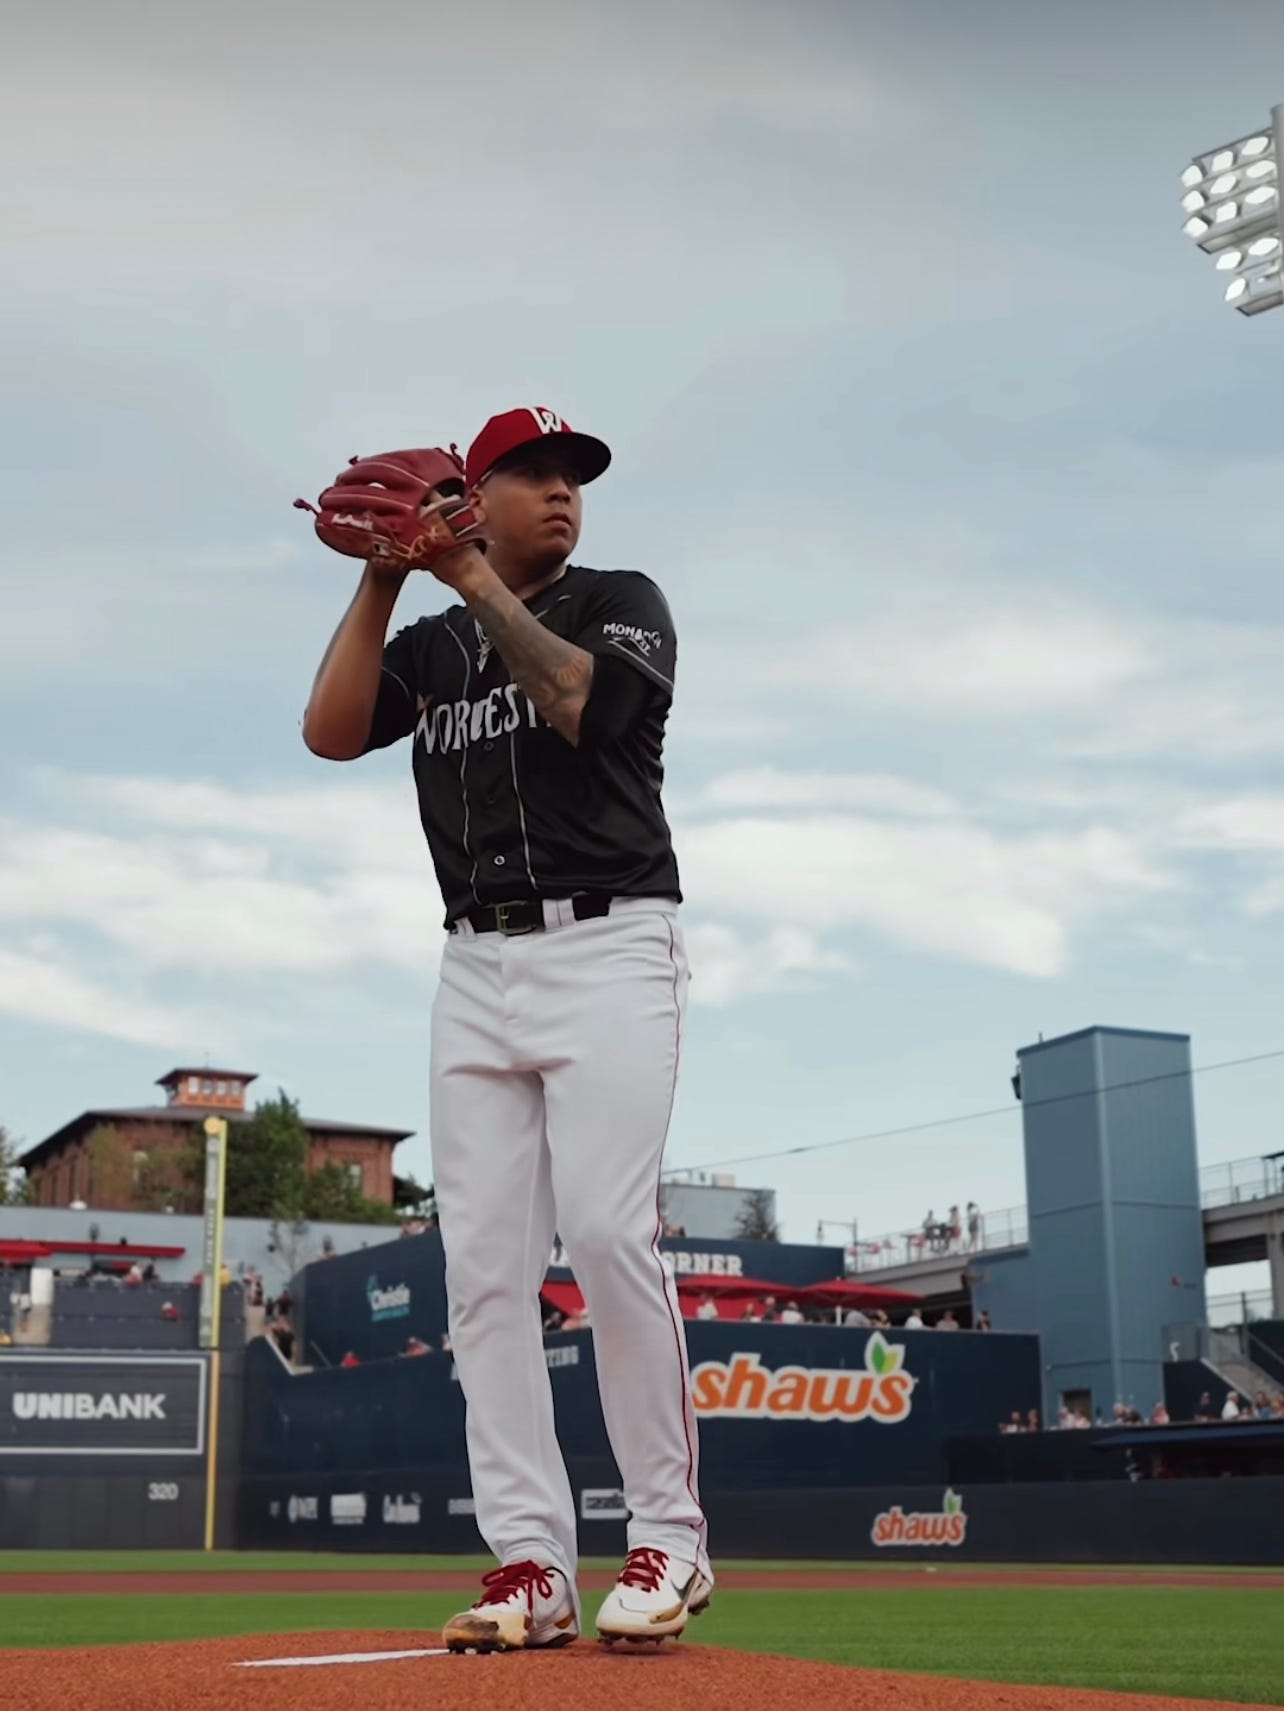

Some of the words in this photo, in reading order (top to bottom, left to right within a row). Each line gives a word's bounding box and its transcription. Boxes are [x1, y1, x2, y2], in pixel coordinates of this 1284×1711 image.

[662, 1252, 743, 1276] ORNER
[13, 1392, 167, 1420] UNIBANK
[148, 1483, 179, 1501] 320
